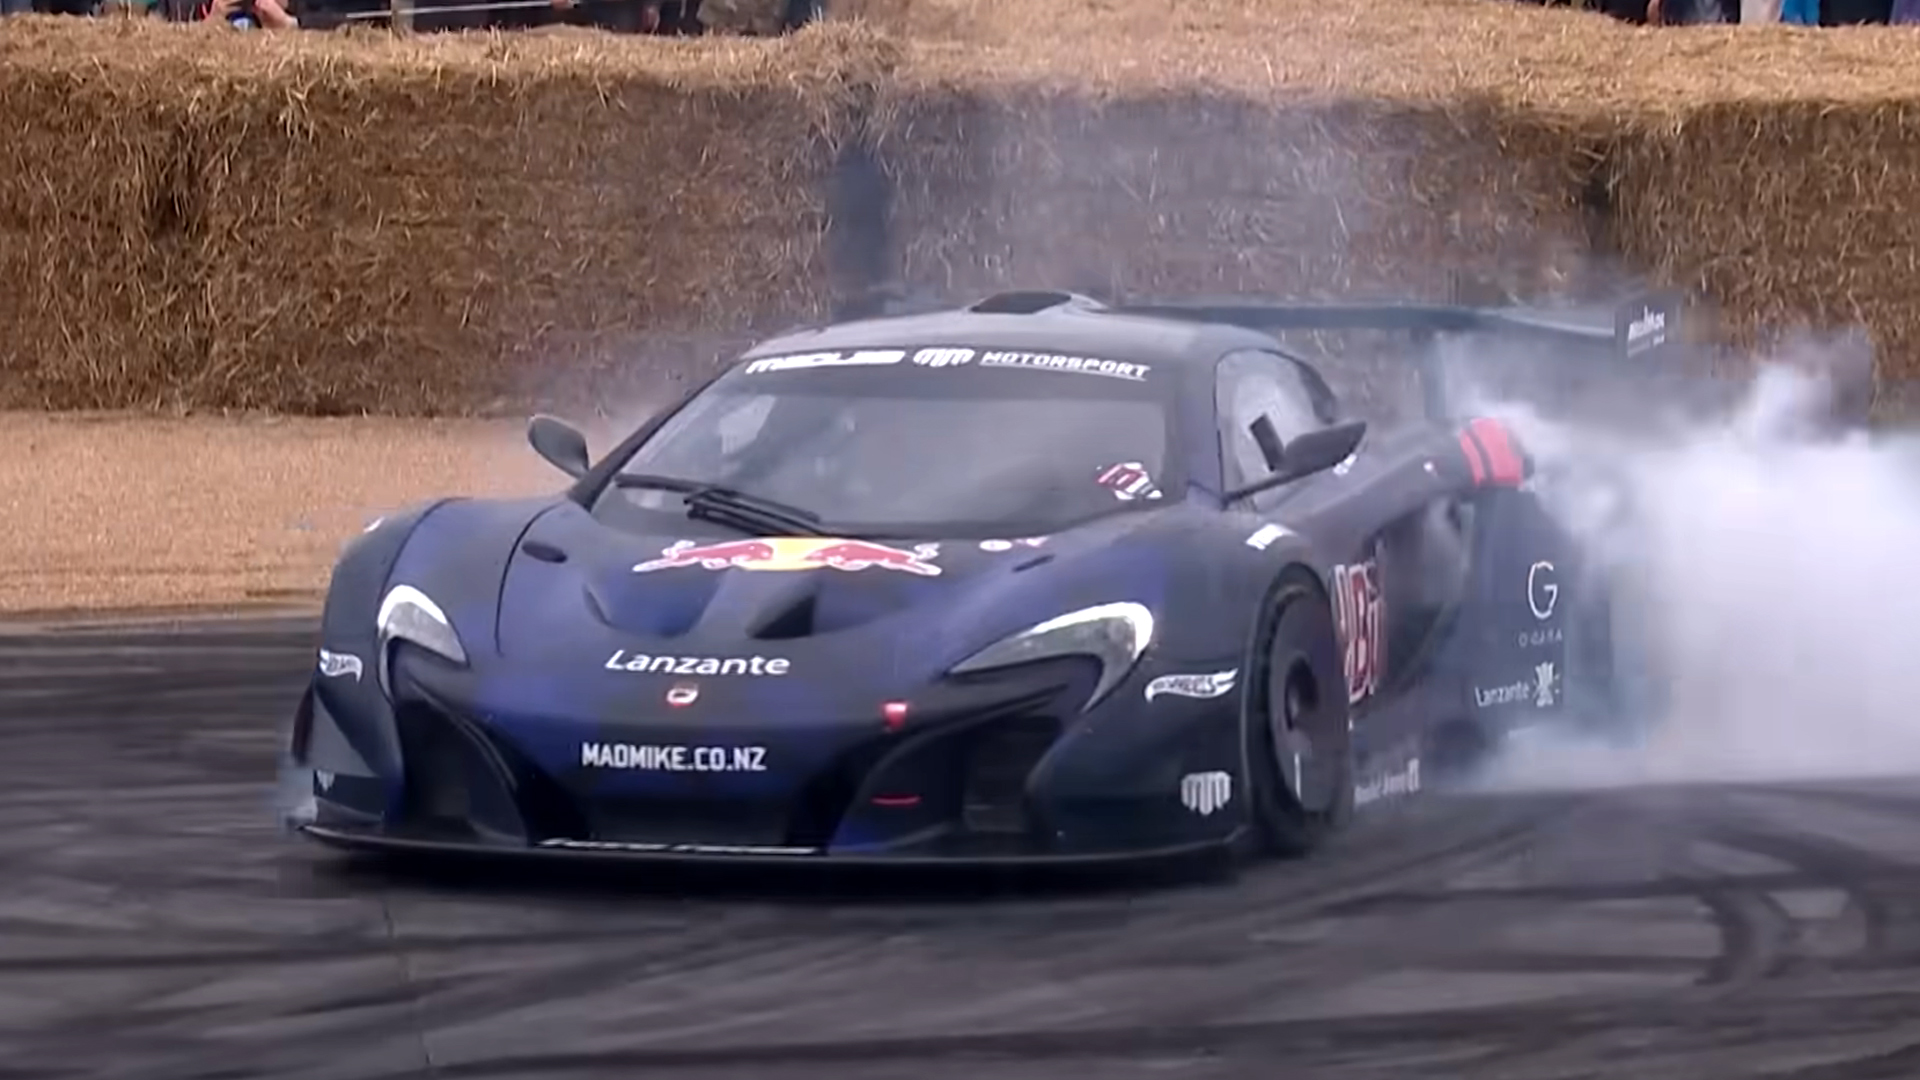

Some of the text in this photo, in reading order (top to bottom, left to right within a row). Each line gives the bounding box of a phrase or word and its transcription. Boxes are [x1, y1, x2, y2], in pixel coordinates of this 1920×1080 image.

[980, 351, 1151, 379] MOTORSPORT
[1528, 561, 1558, 619] G
[605, 649, 791, 675] Lanzante
[582, 743, 768, 771] MADMIKE.CO.NZ
